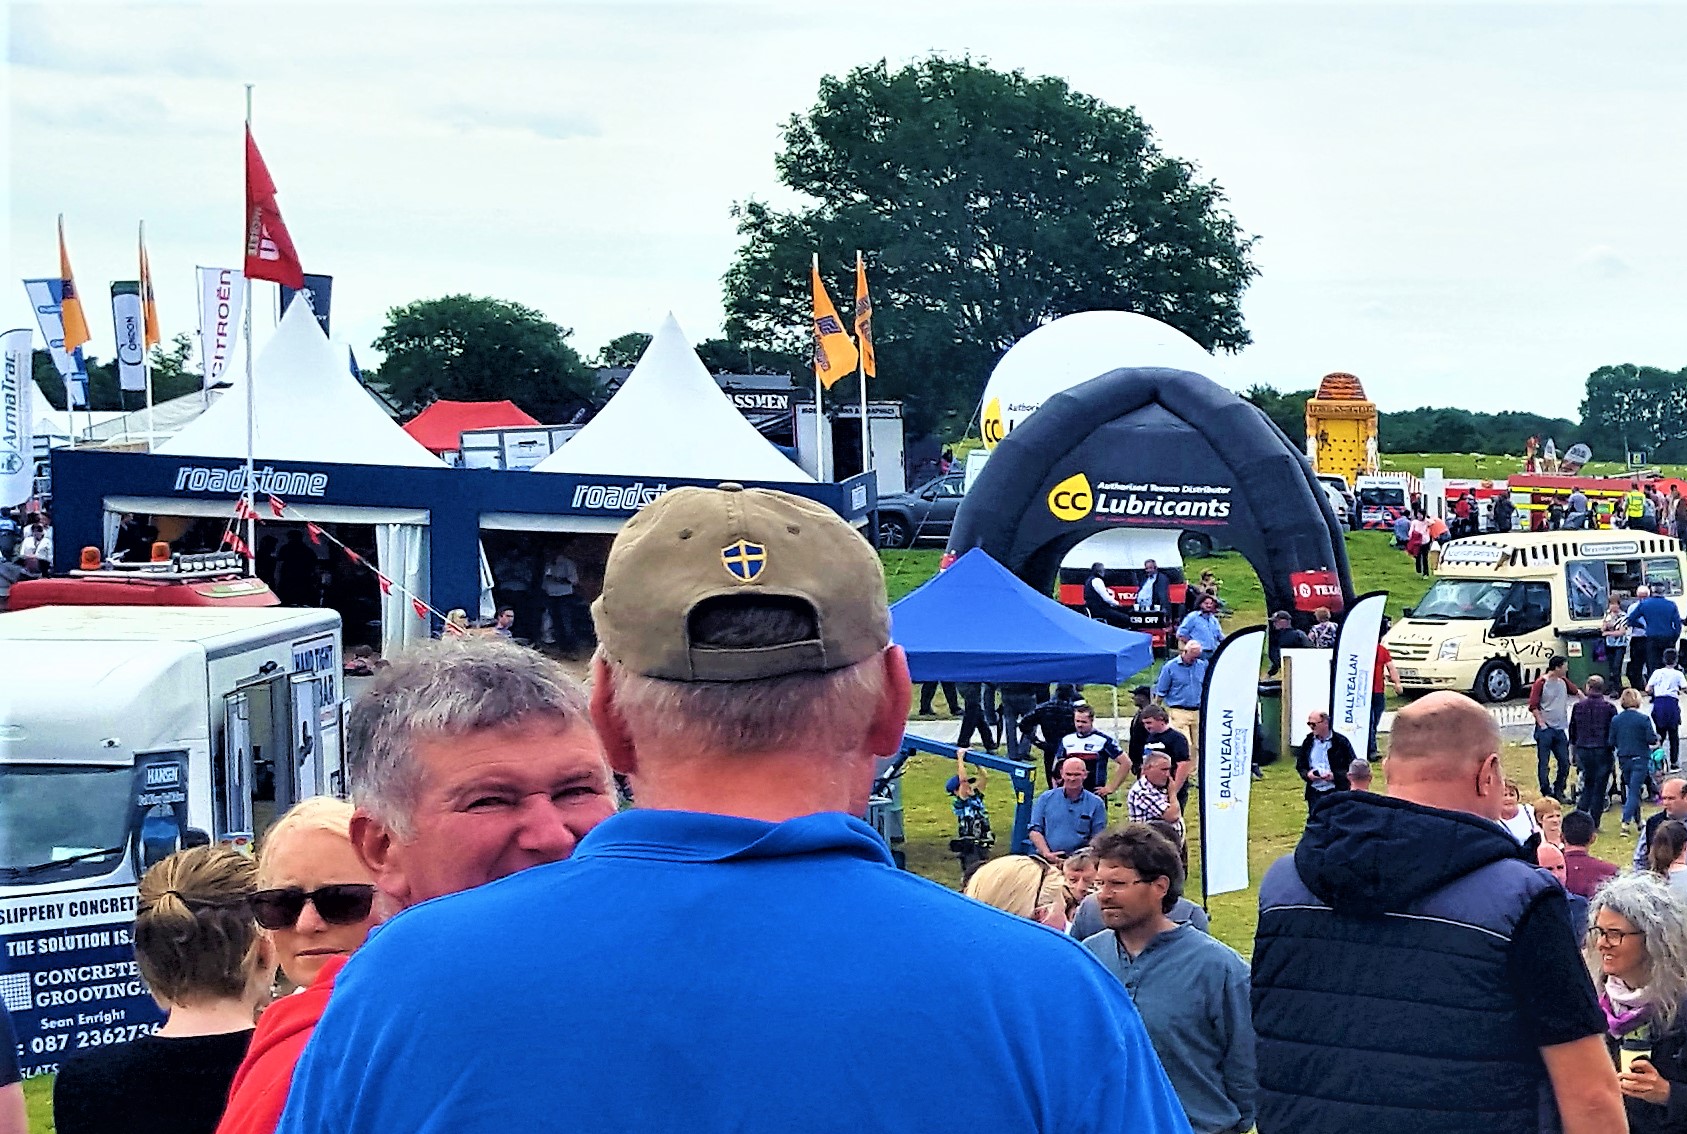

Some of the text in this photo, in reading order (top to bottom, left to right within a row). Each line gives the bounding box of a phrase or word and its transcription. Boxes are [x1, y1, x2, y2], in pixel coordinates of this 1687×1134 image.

[1, 351, 17, 448] ArmaTrac
[985, 418, 1002, 443] CC
[174, 466, 328, 497] roadstone
[1054, 491, 1087, 511] CC
[1095, 493, 1231, 517] Lubricants
[1220, 708, 1234, 799] BALLYEALAN
[0, 896, 139, 926] SLIPPERY CONCRET
[5, 938, 35, 957] THE
[38, 930, 110, 954] SOLUTION
[34, 960, 140, 986] CONCRETE
[40, 1008, 126, 1030] Sean Enright
[31, 1033, 70, 1054] 087
